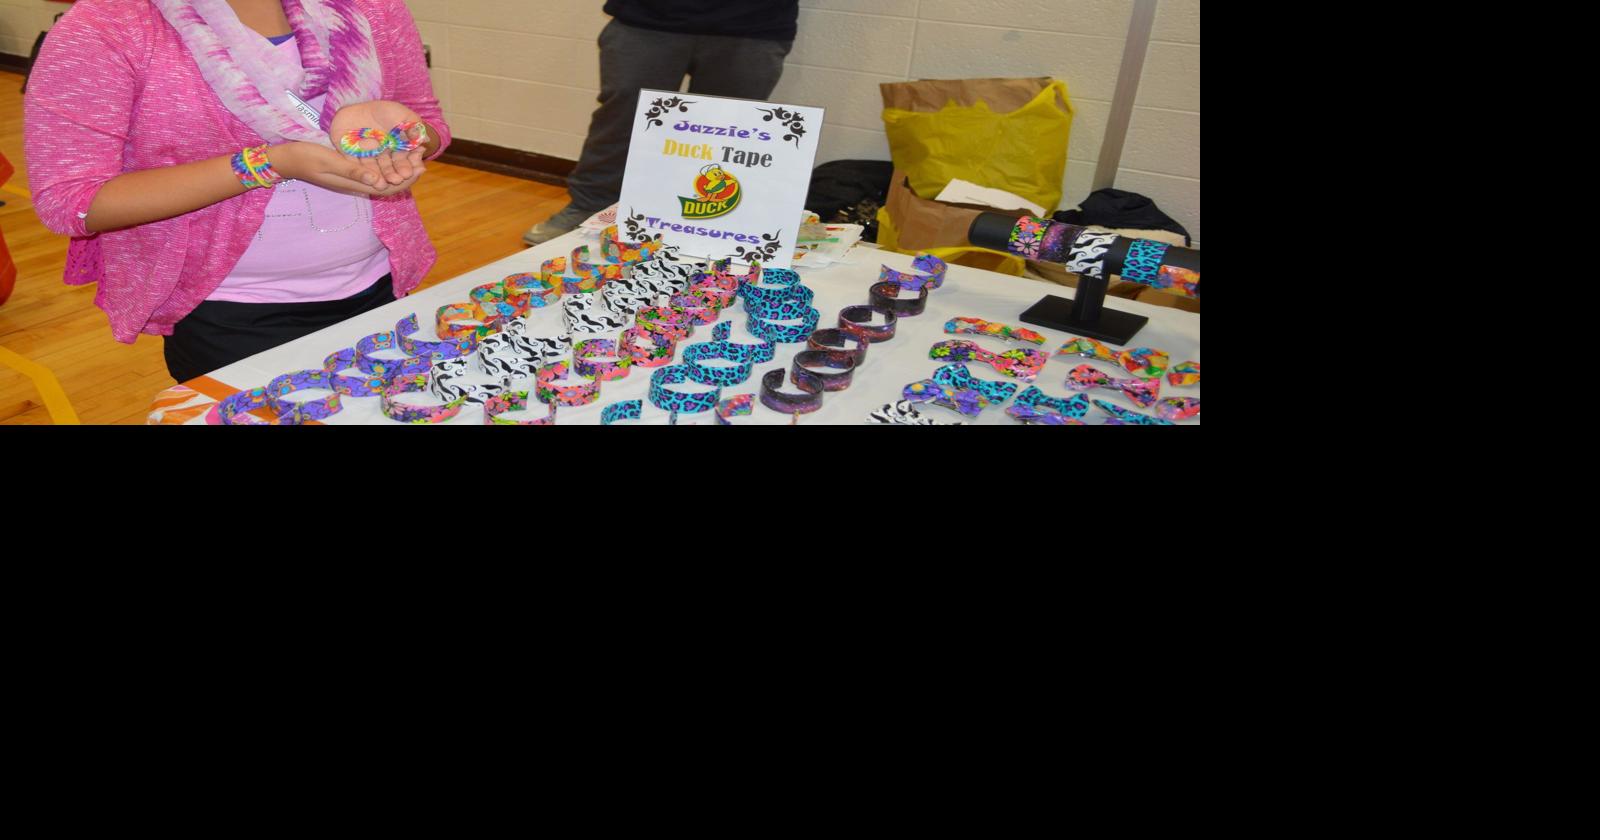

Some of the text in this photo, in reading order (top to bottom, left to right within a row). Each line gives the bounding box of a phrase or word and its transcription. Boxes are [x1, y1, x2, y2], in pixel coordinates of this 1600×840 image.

[673, 120, 772, 141] Jazzie's
[662, 138, 773, 168] Duck Tape
[683, 200, 728, 215] DUCK
[645, 216, 761, 244] Treasures
